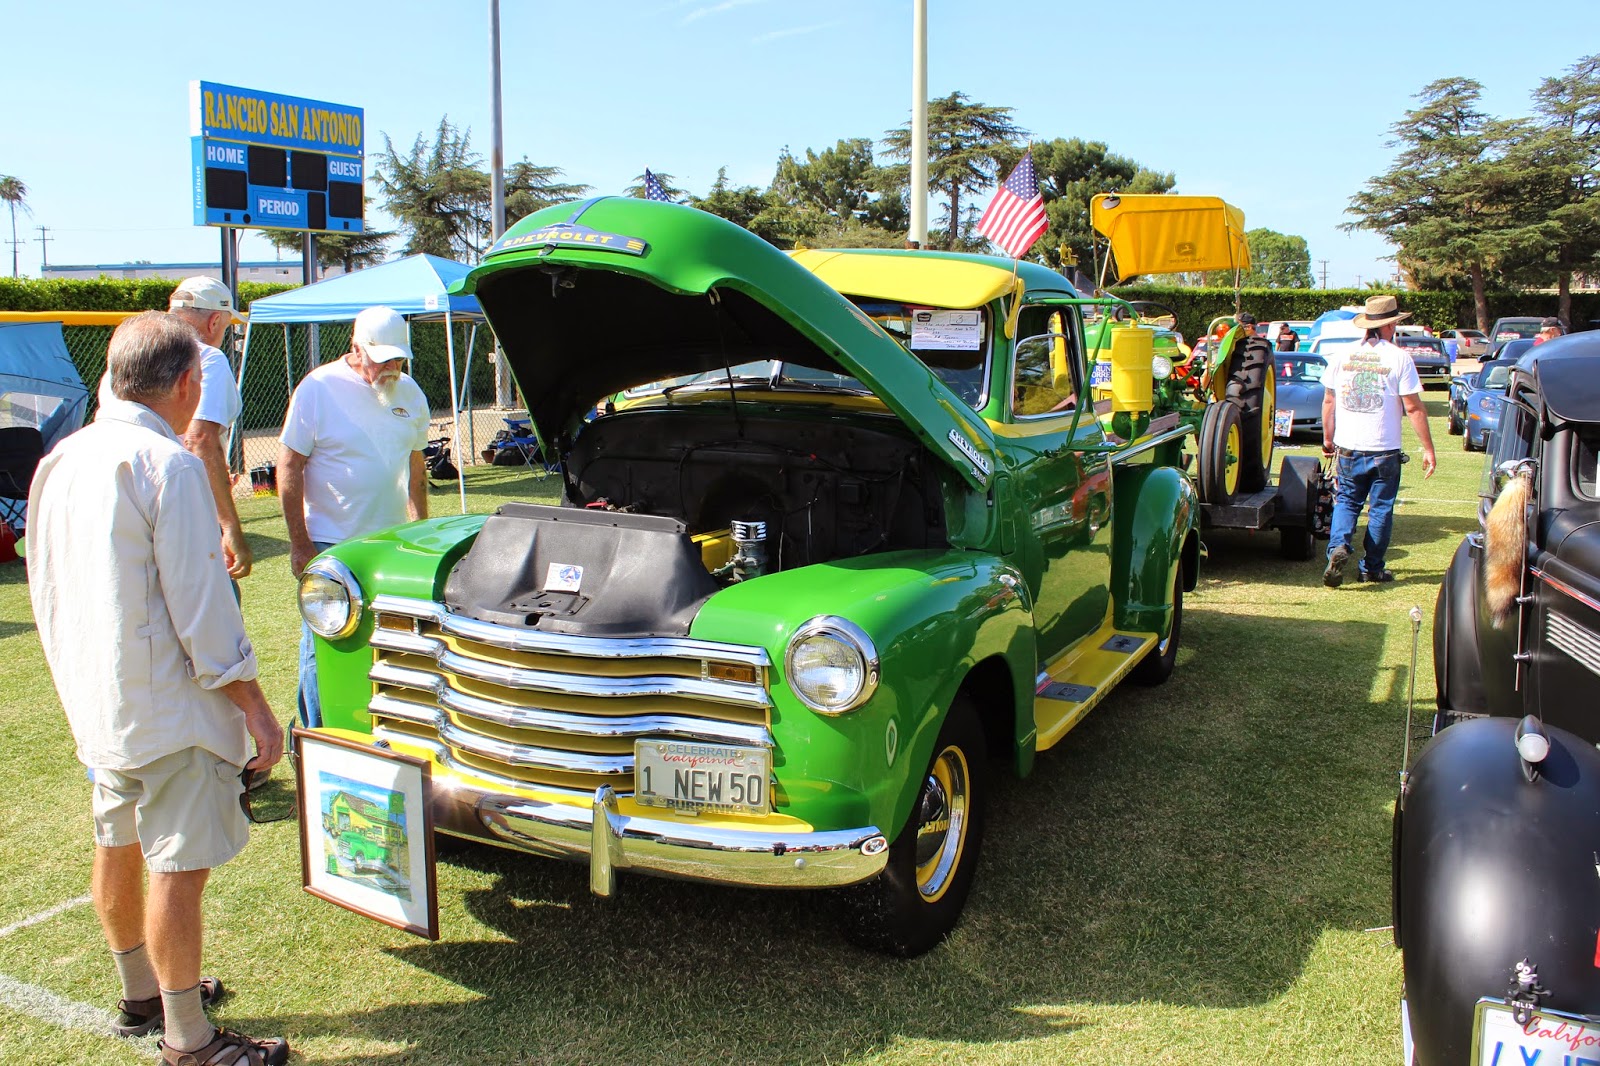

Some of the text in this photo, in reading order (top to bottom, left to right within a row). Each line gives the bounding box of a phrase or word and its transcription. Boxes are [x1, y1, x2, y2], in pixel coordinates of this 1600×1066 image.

[204, 91, 361, 147] RANCHO SAN ANTONIO
[207, 145, 245, 165] HOME
[329, 161, 361, 177] GUEST
[259, 198, 299, 216] PERIOD
[502, 231, 614, 247] CHEVROLET
[667, 743, 738, 758] CELEBRATE
[664, 753, 744, 768] California
[642, 766, 656, 795] 1
[1511, 1000, 1534, 1010] FELIX
[1523, 1015, 1600, 1051] Califo
